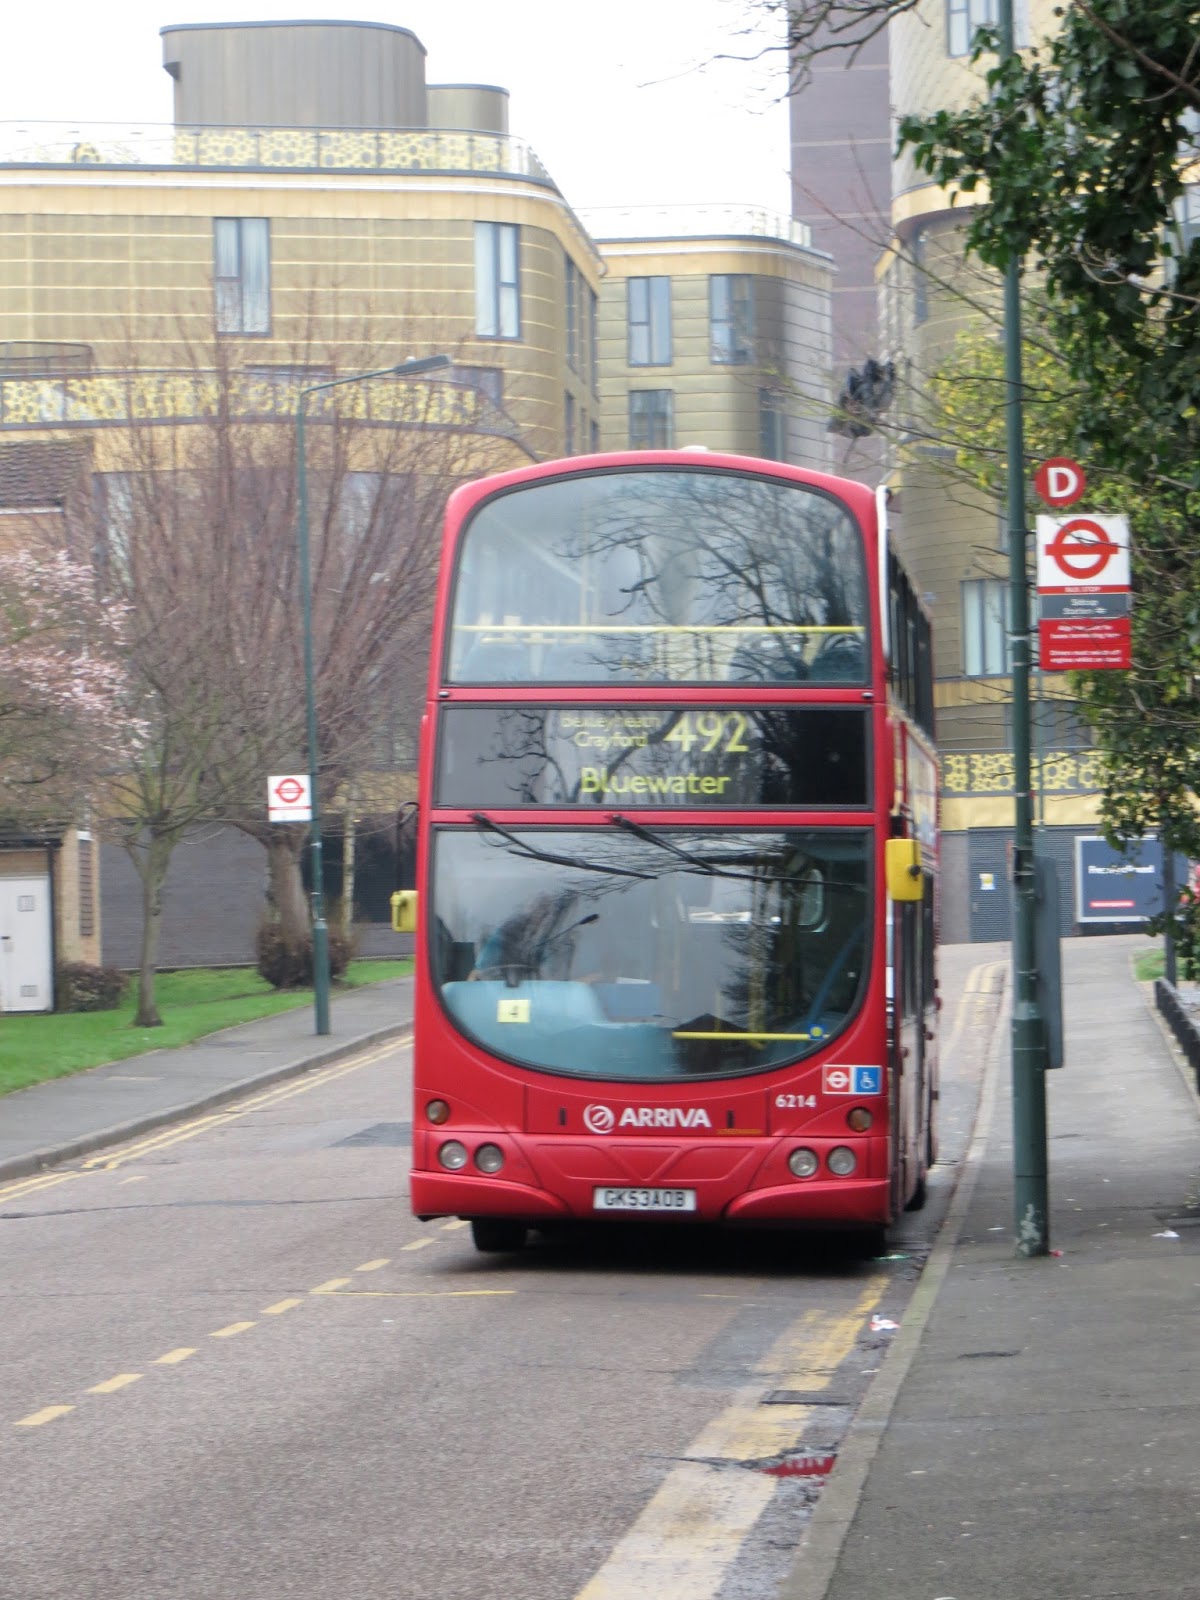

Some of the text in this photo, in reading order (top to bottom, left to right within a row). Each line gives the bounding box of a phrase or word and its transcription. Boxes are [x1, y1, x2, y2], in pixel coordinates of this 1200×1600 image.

[1047, 467, 1078, 498] D
[573, 731, 649, 751] Crayford
[663, 711, 750, 752] 492
[580, 766, 732, 795] Bluewater
[775, 1094, 817, 1108] 6214
[618, 1107, 712, 1129] ARRIVA
